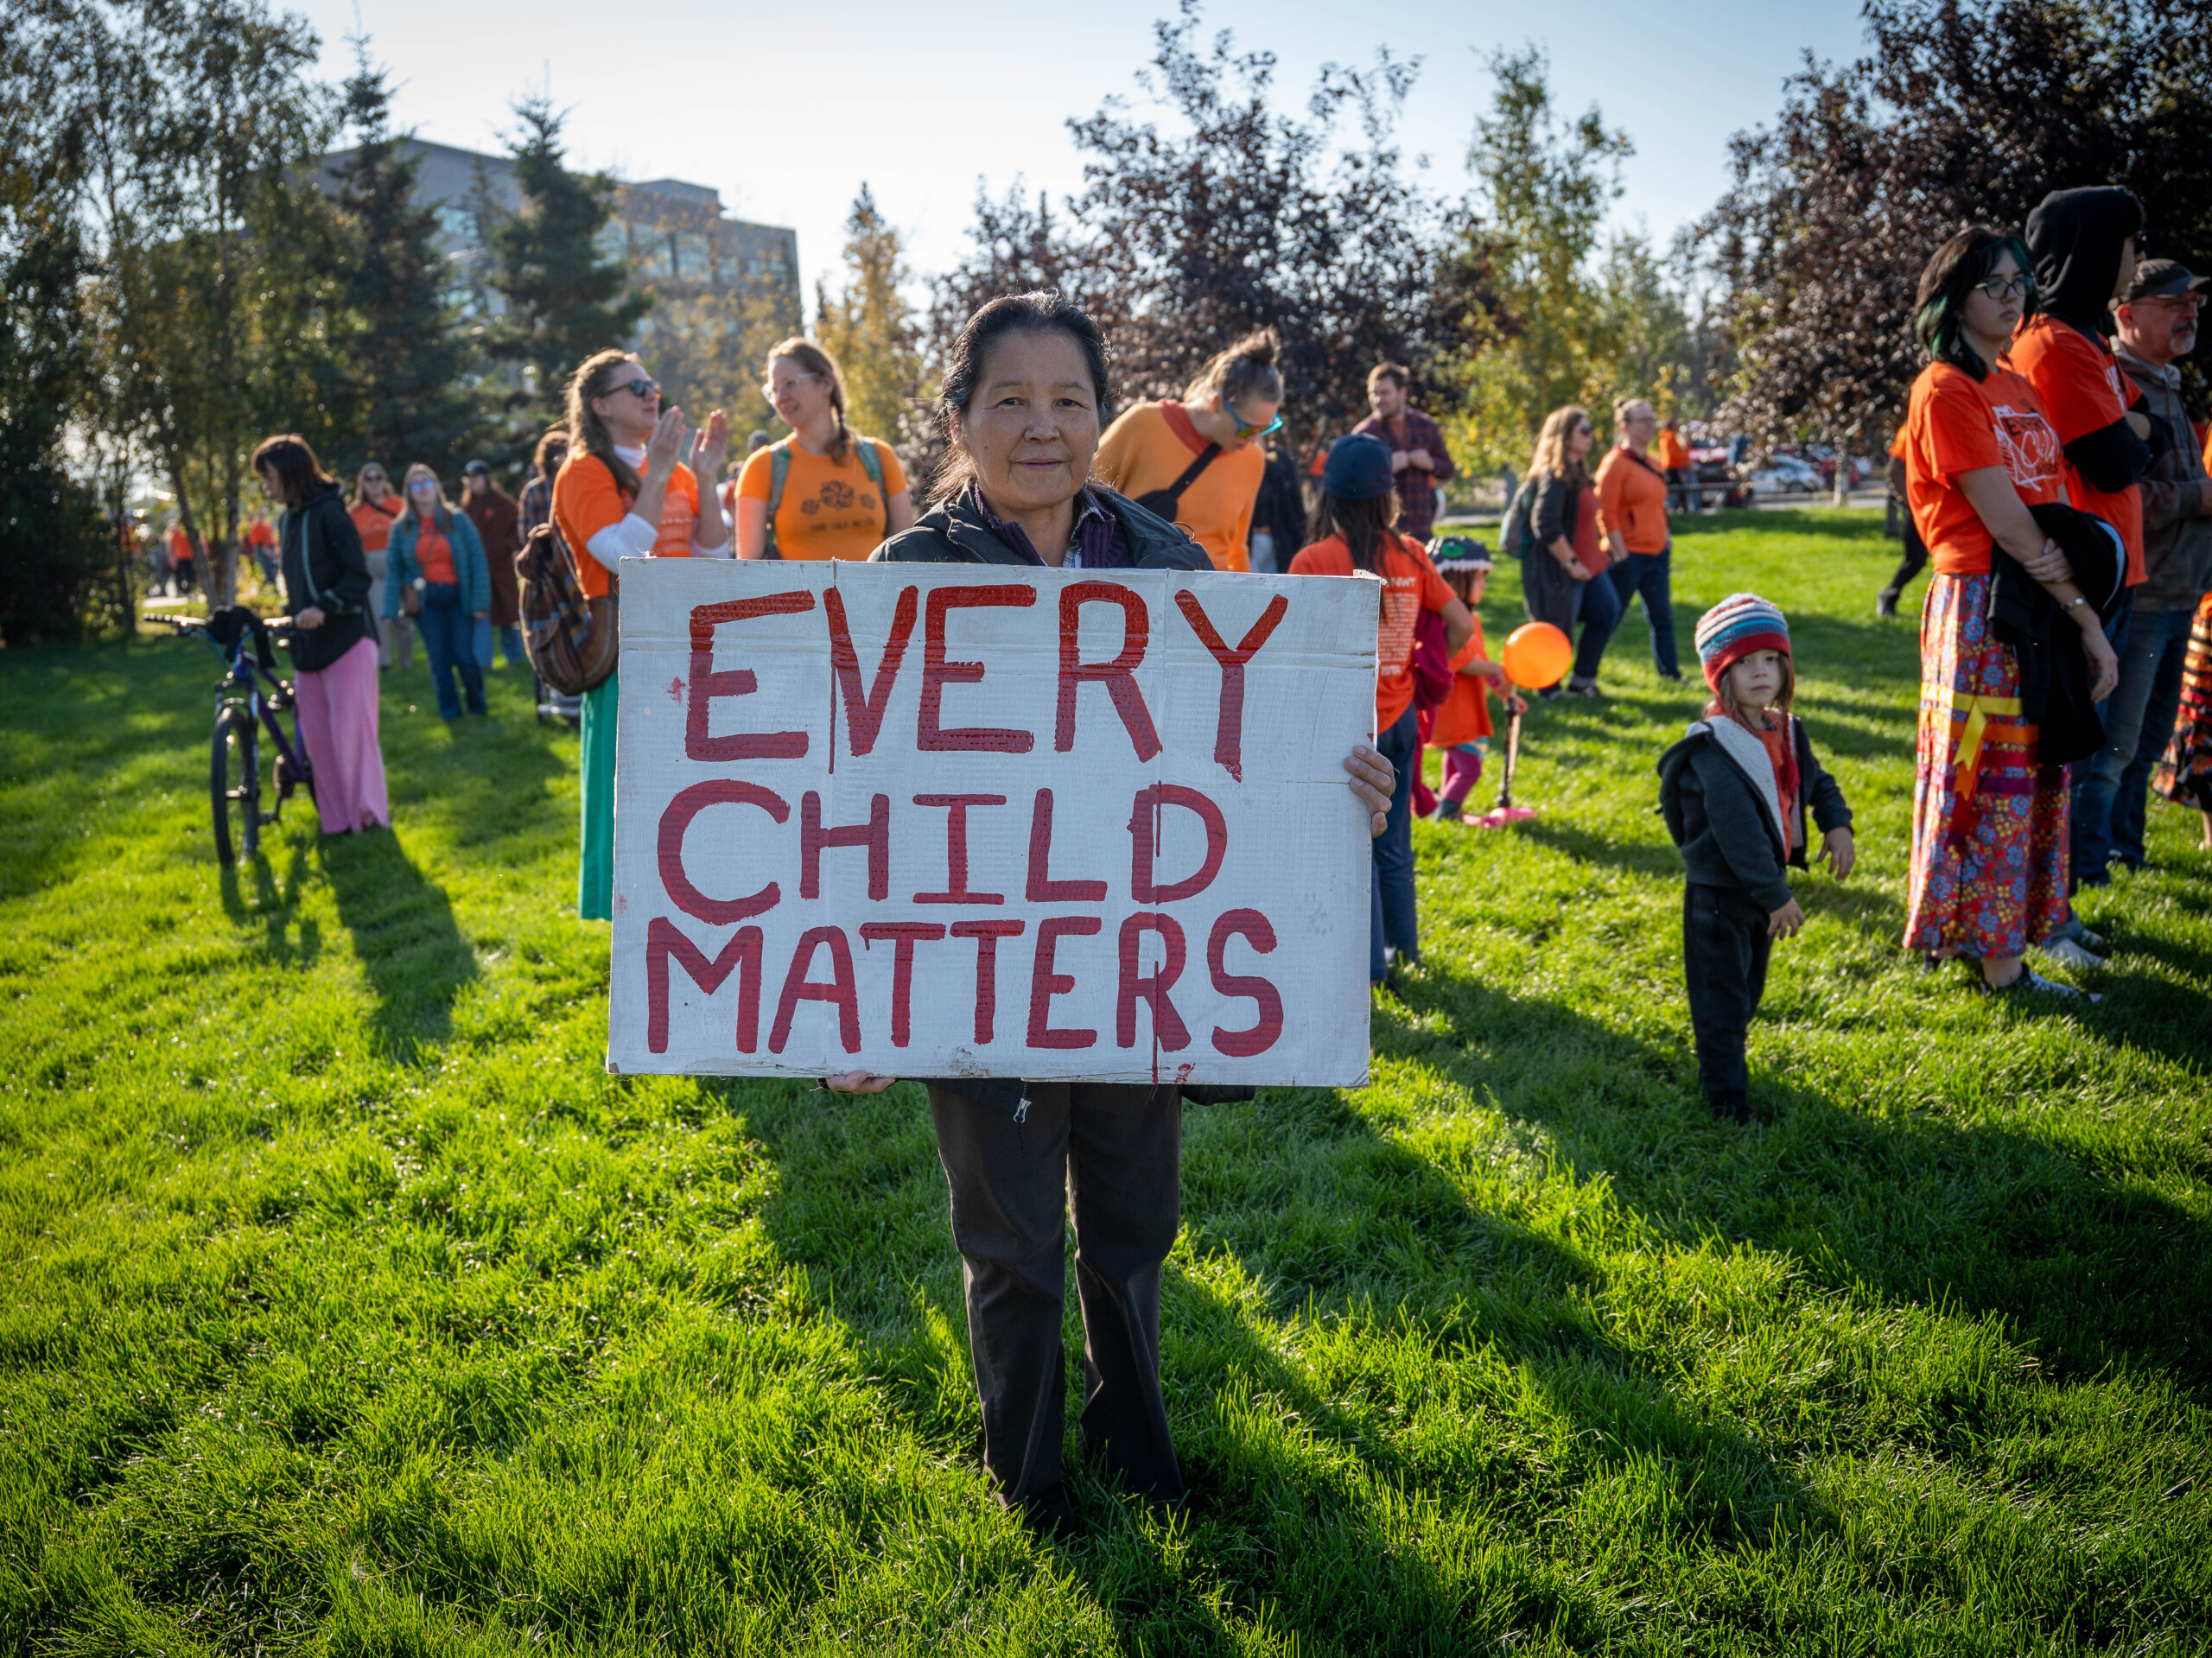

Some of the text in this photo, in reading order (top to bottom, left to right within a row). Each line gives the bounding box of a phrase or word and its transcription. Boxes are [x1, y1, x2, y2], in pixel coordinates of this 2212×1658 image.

[685, 580, 1288, 781] EVERY
[658, 779, 1228, 925] CHILD
[647, 908, 1284, 1058] MATTERS
